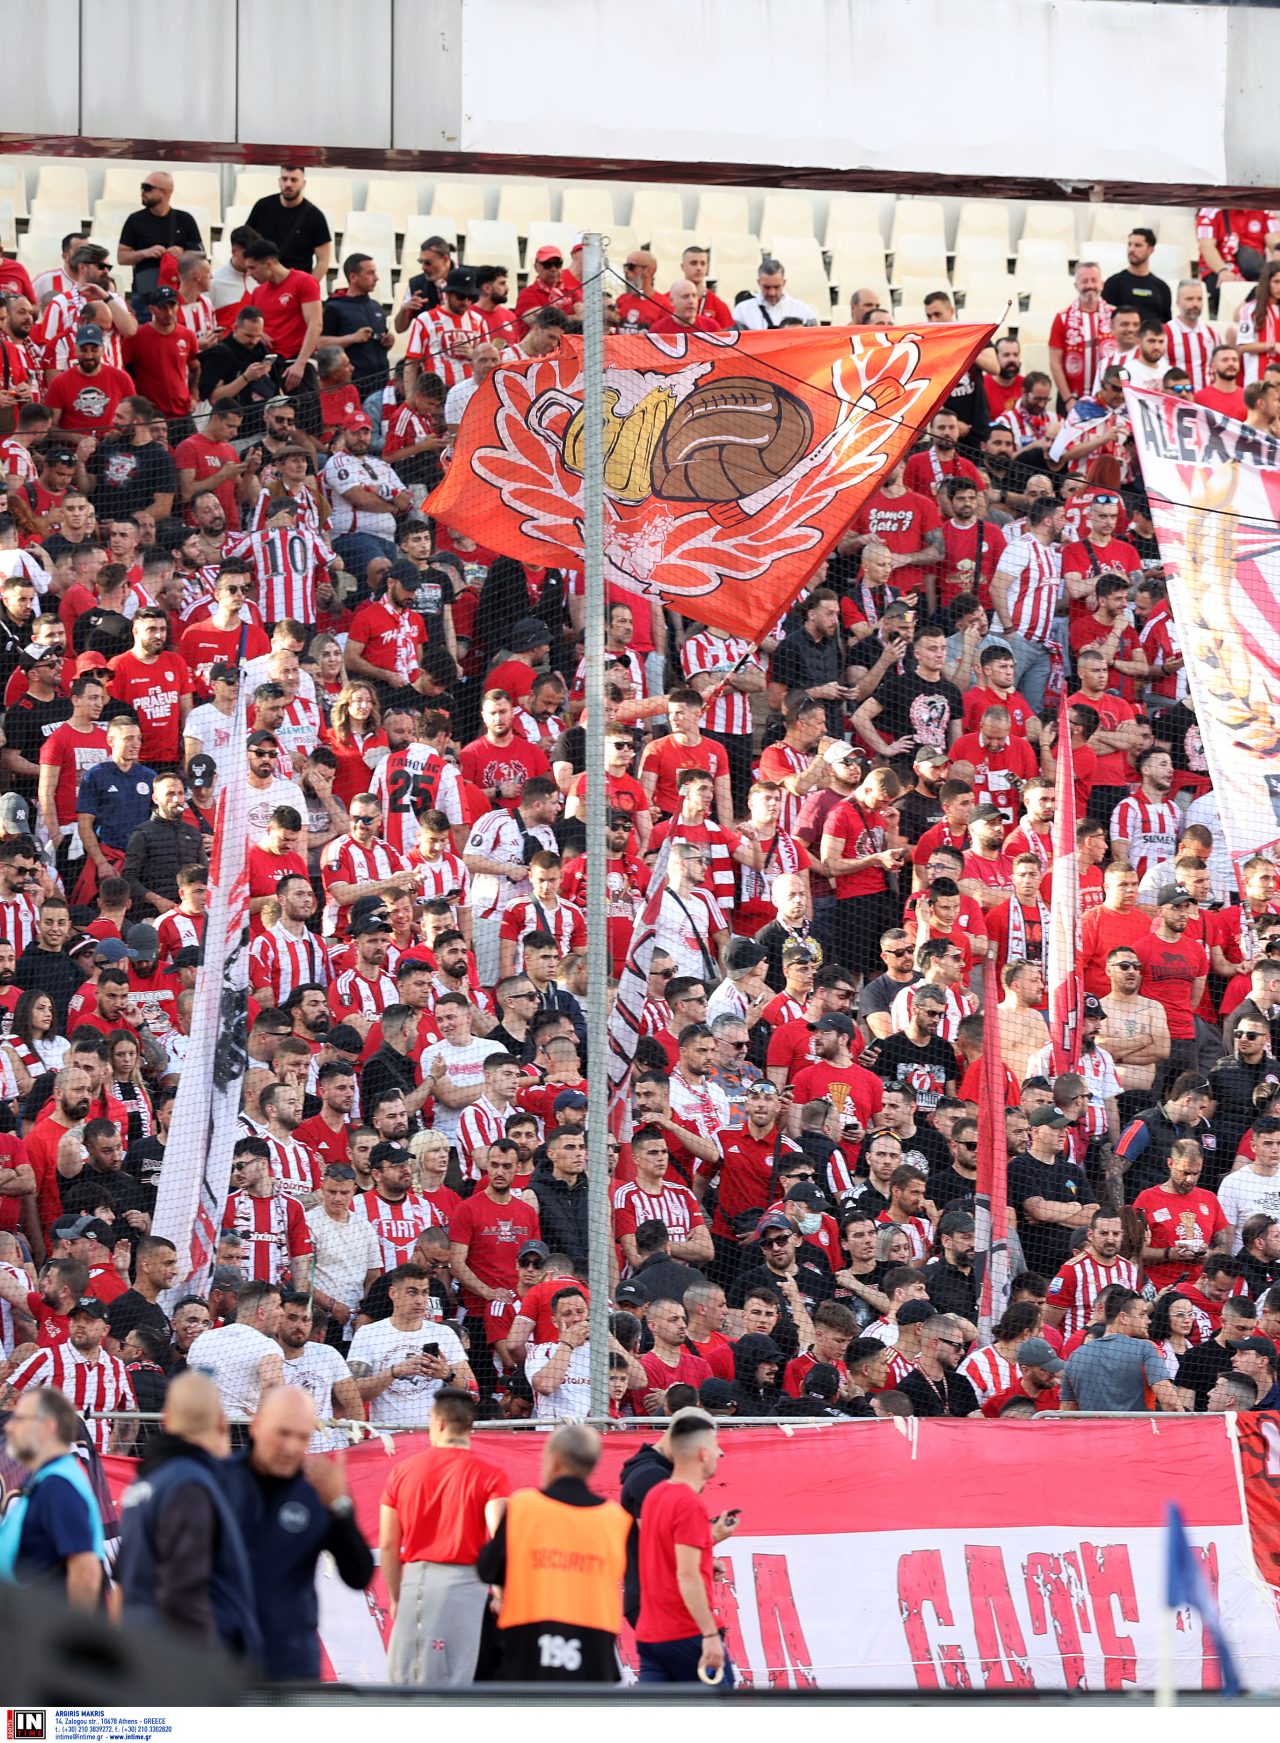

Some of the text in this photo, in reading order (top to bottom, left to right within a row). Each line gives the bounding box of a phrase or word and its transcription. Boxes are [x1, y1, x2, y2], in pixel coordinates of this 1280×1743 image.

[868, 508, 913, 522] Samos
[869, 520, 911, 535] Gate 7
[262, 535, 309, 577] 10
[133, 690, 178, 710] PIRAEUS
[144, 705, 171, 720] TIME
[390, 757, 441, 775] ZAHOVIC
[390, 769, 436, 819] 25
[382, 1219, 416, 1238] FIAT
[532, 1548, 607, 1574] SECURITY
[537, 1633, 583, 1672] 196
